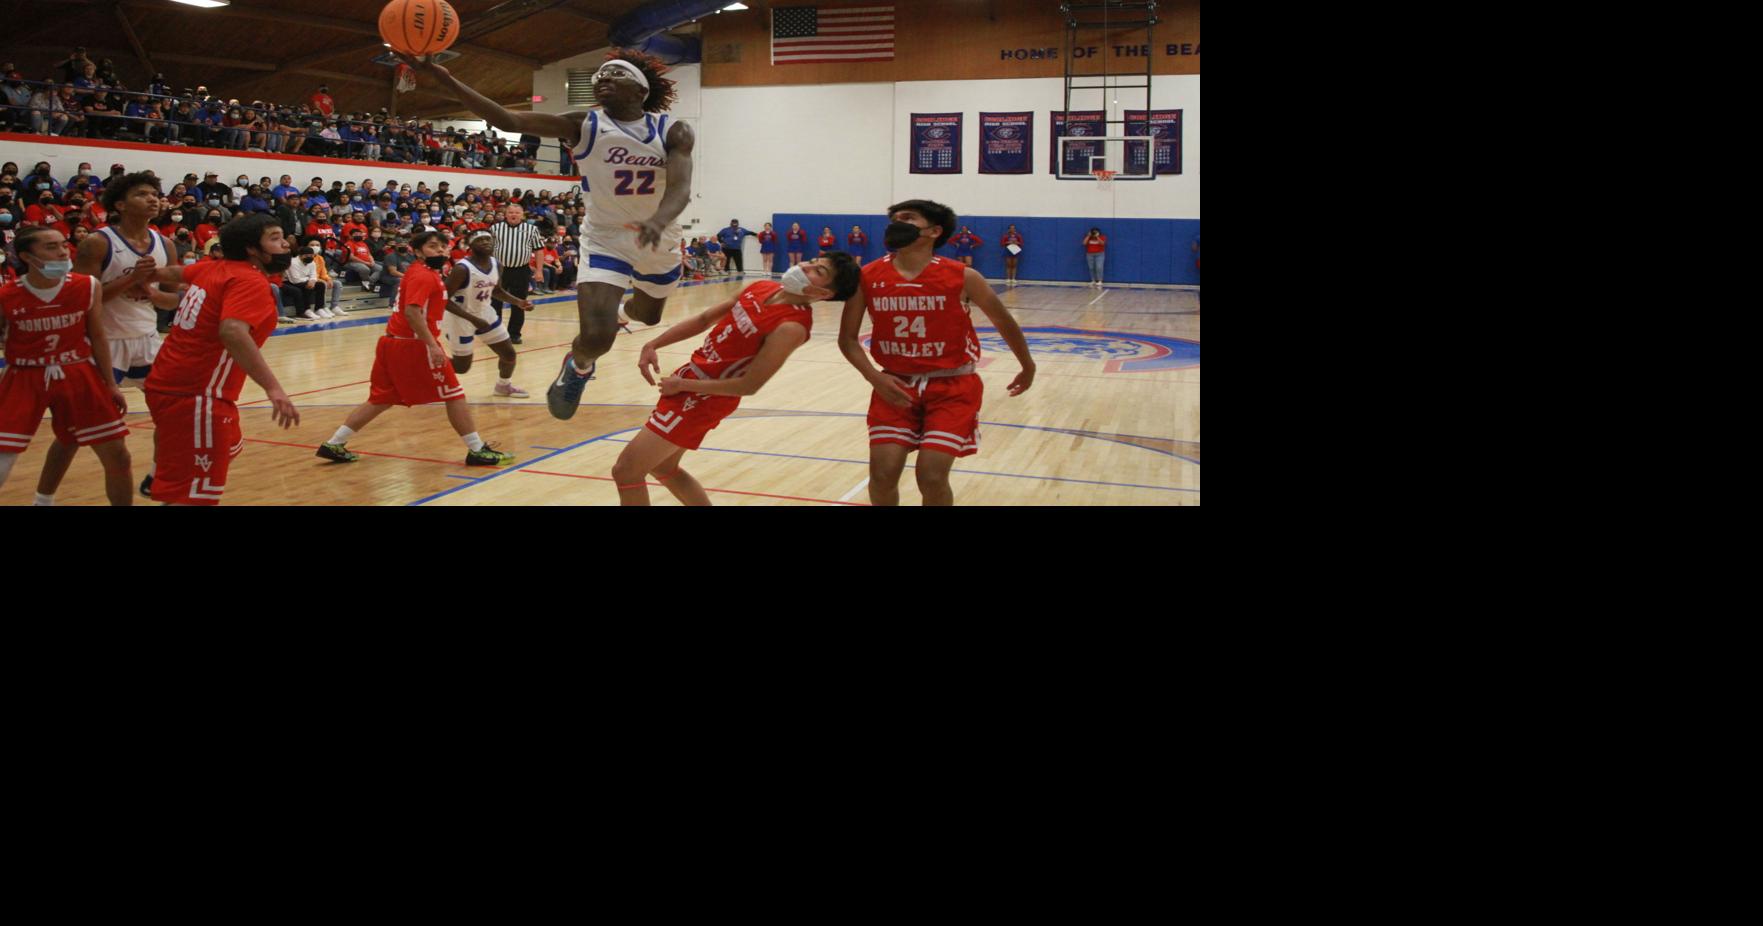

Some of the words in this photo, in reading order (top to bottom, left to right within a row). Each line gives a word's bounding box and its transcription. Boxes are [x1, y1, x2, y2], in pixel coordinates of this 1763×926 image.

[1001, 48, 1058, 60] HOME
[1073, 47, 1099, 58] OF
[1112, 45, 1150, 57] THE
[614, 170, 656, 196] 22
[873, 296, 946, 311] MONUMENT
[16, 311, 84, 332] MONUMENT
[893, 315, 927, 338] 24
[44, 334, 60, 353] 3
[880, 341, 945, 357] VALLEY
